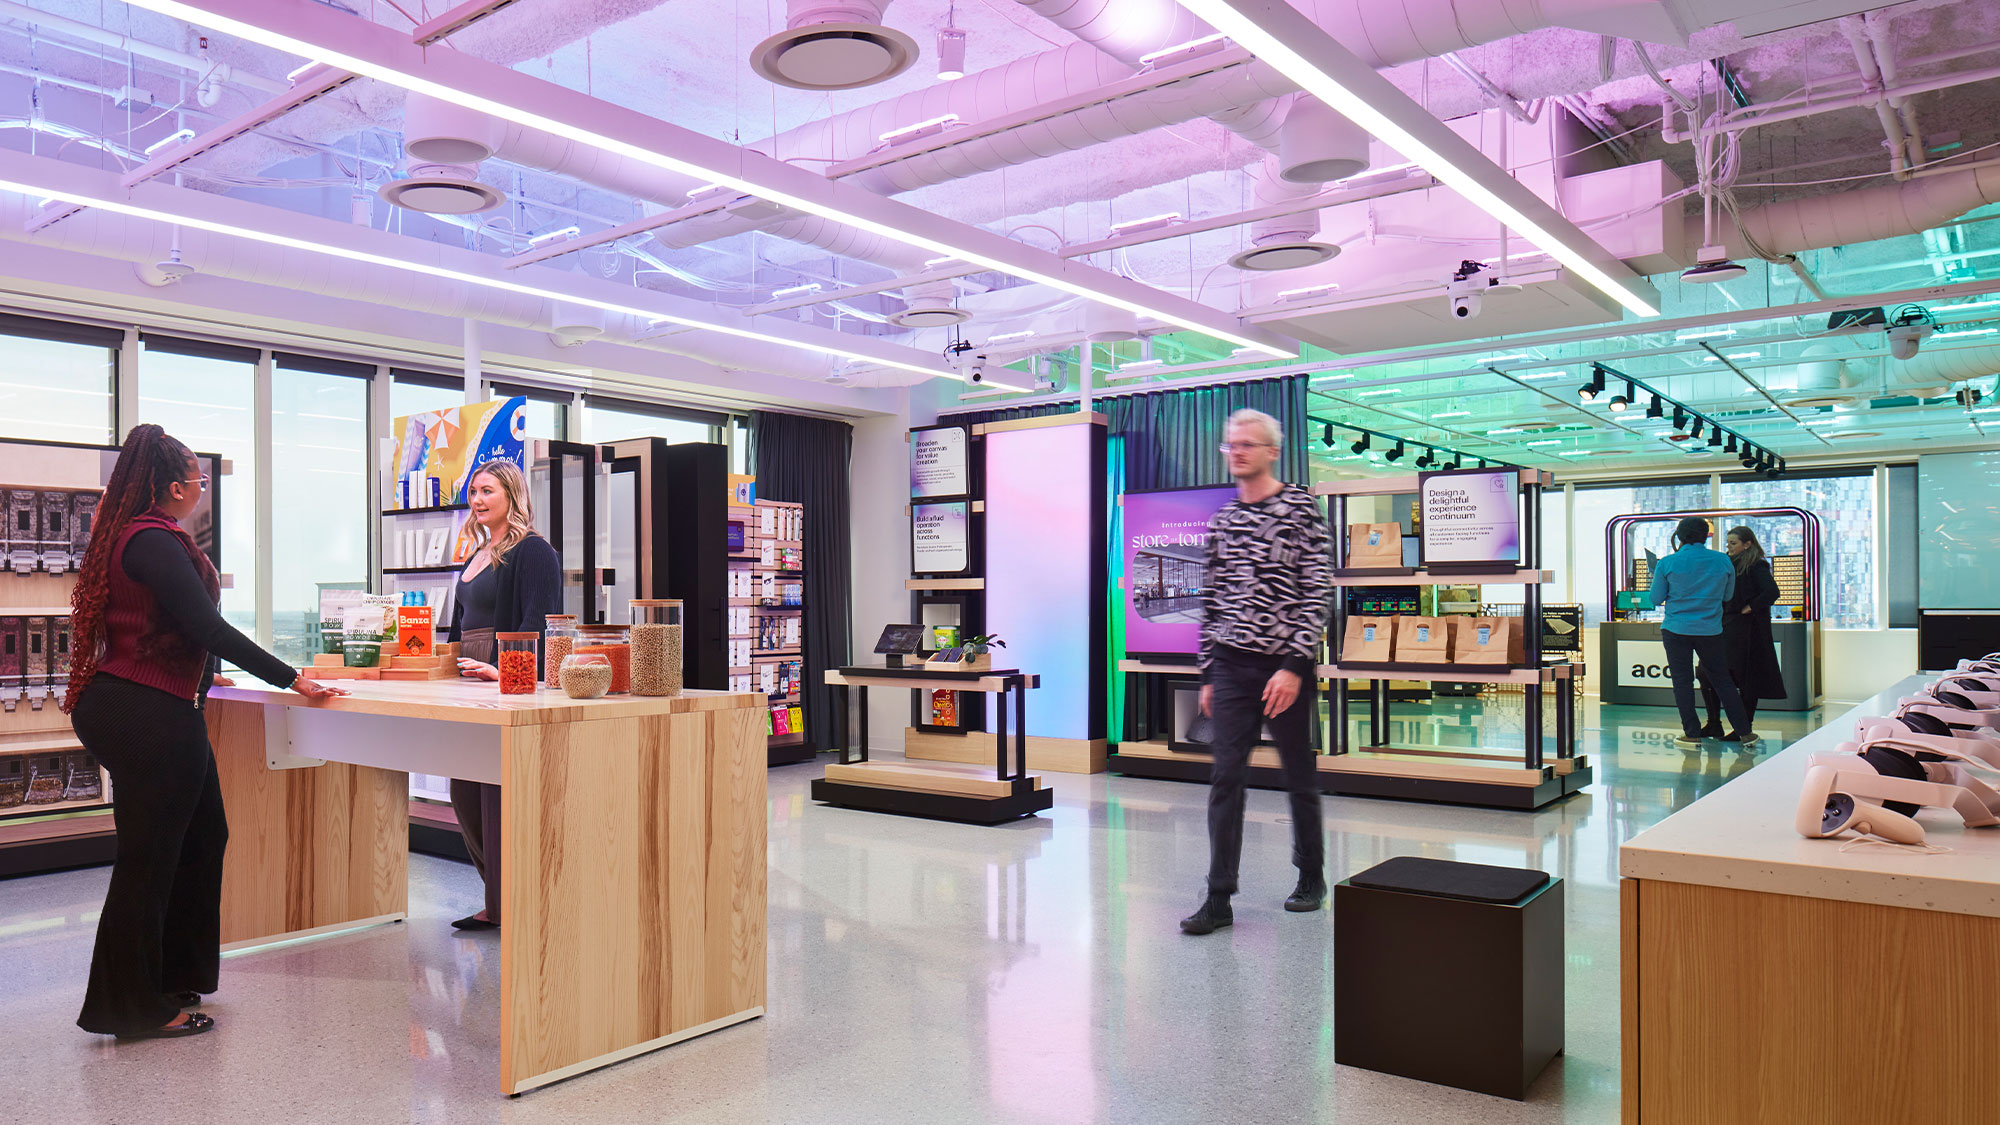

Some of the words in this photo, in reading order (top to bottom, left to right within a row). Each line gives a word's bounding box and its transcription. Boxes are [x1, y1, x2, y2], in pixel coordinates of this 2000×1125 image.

[492, 445, 505, 456] hello
[1429, 489, 1458, 498] Design
[1429, 496, 1469, 506] delightful
[1429, 504, 1477, 513] experience
[1429, 512, 1475, 520] continuum
[1161, 520, 1211, 529] Introducing
[1132, 533, 1170, 548] store
[400, 615, 430, 624] Banza
